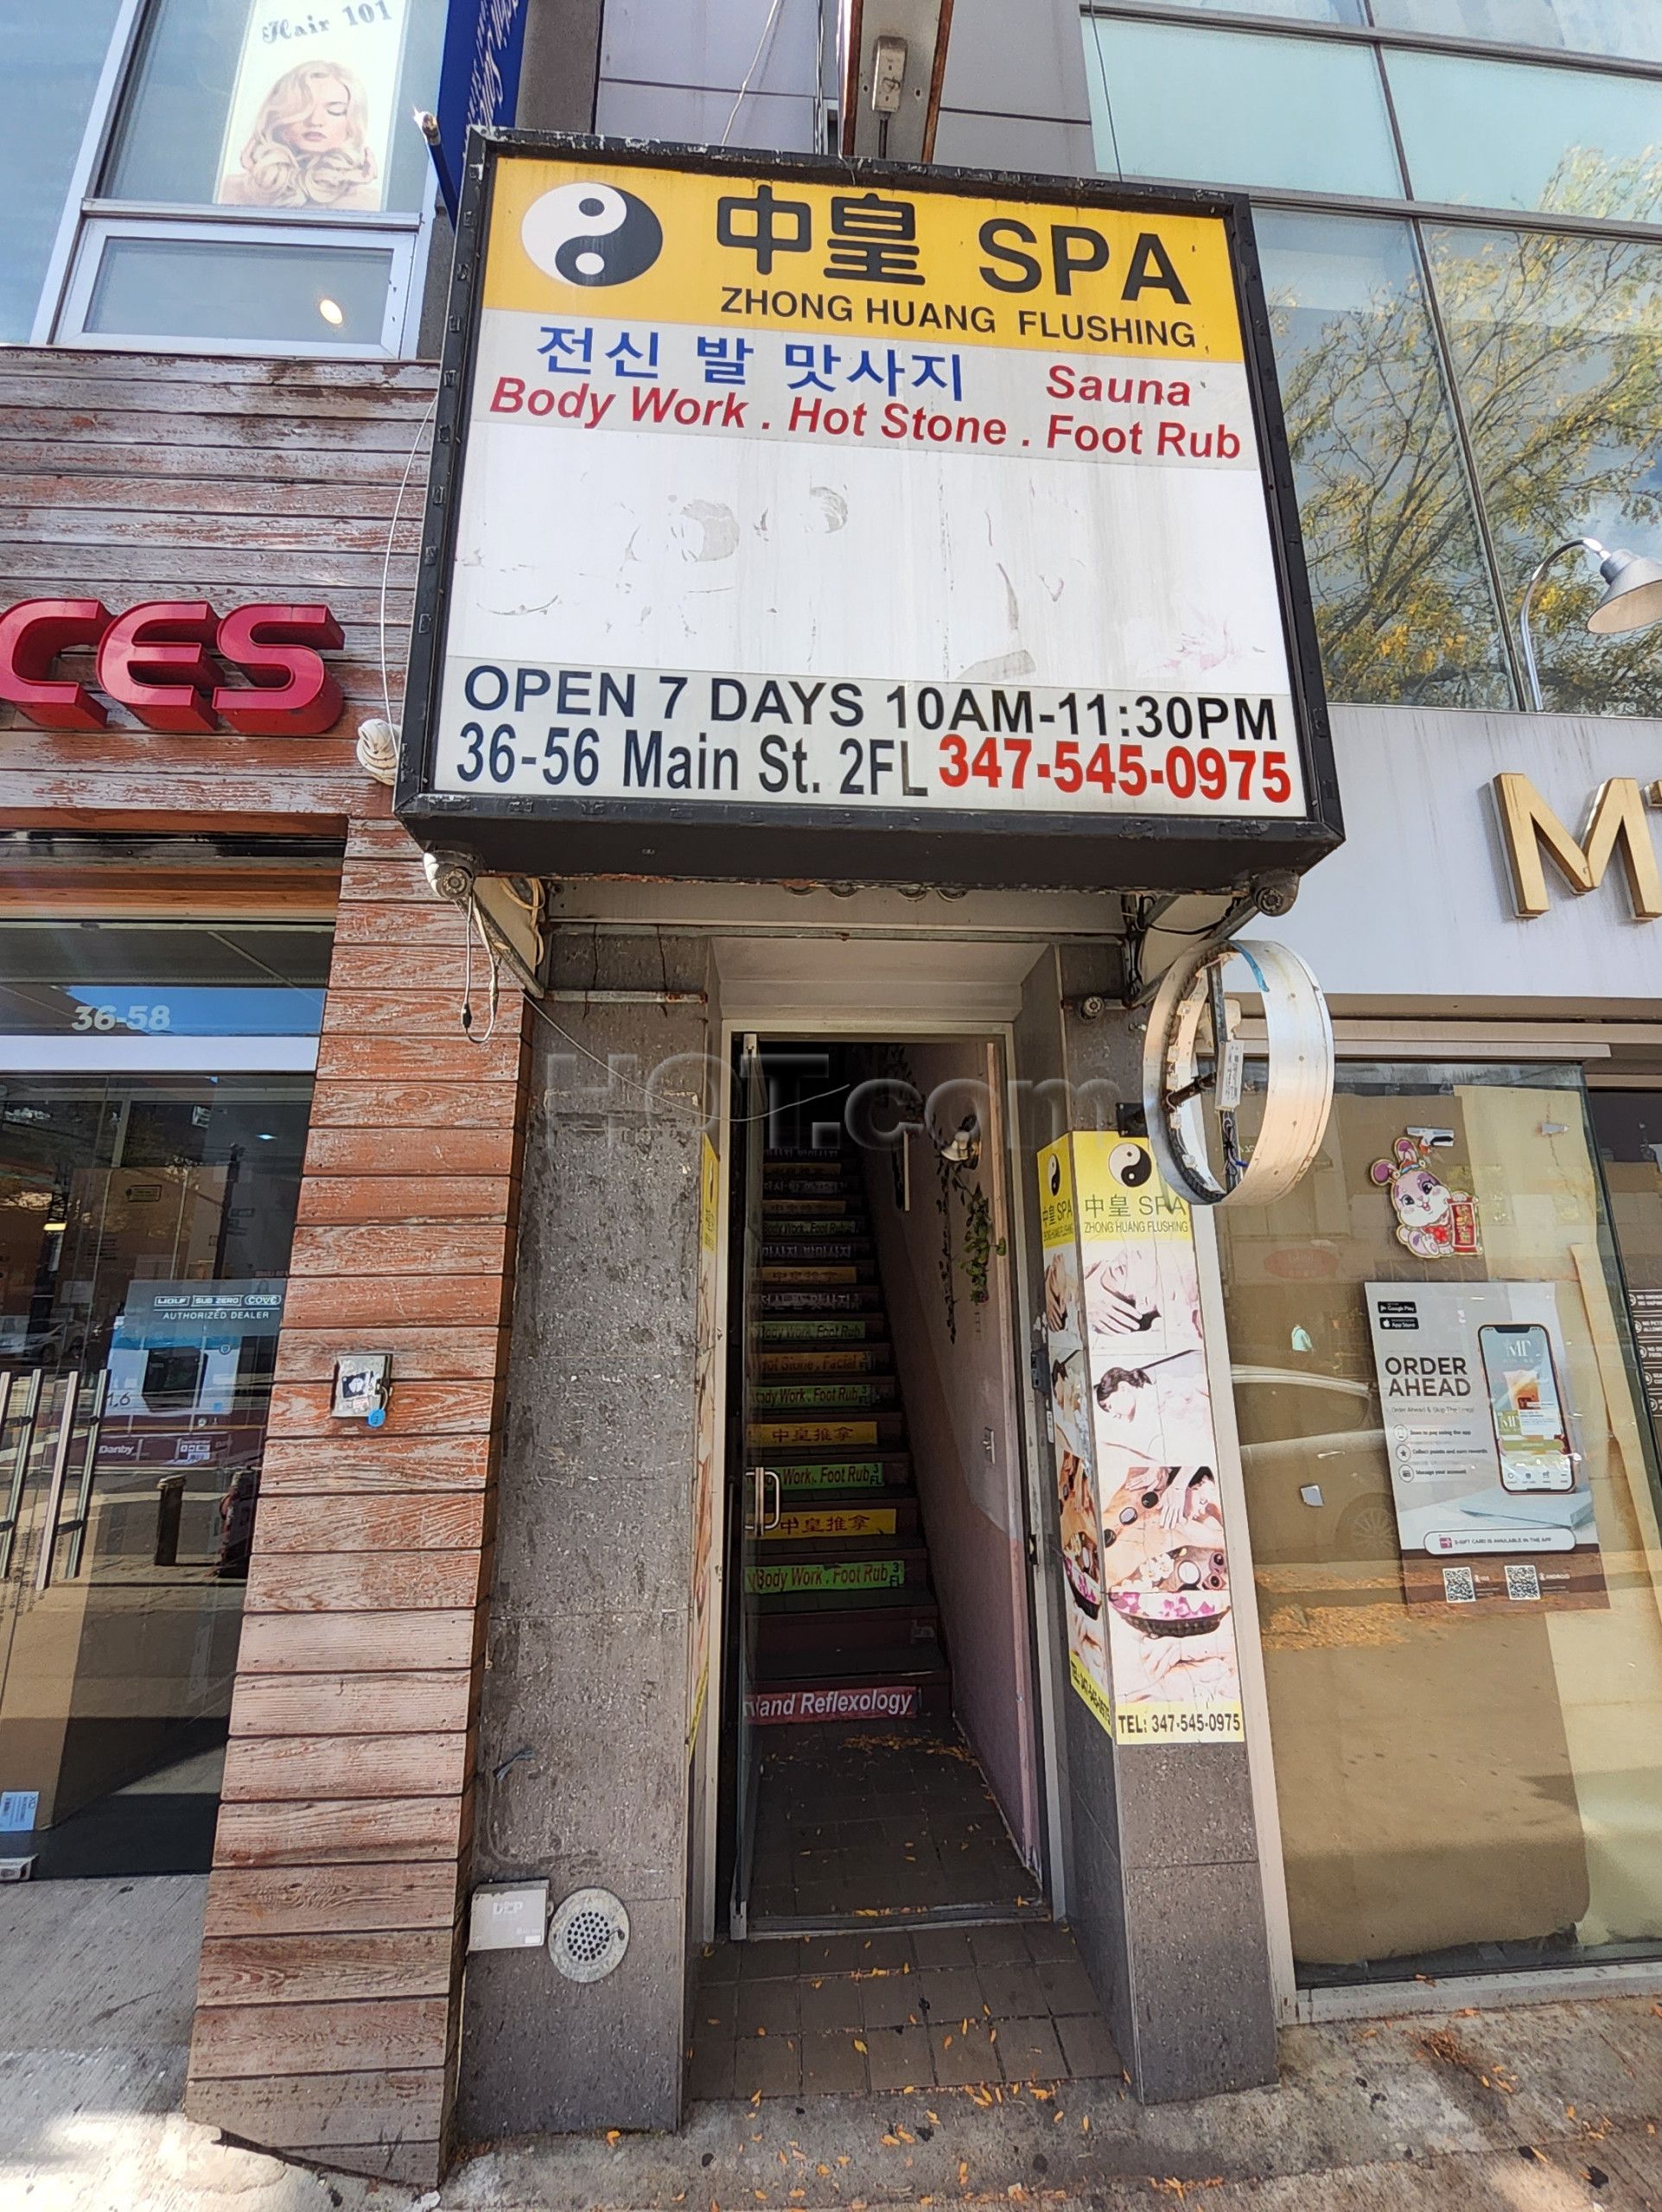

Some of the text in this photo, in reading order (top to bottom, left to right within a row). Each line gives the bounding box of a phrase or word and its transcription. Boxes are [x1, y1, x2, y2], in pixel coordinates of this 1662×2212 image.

[262, 0, 393, 44] Hair 101
[717, 184, 928, 285] 中皇
[979, 219, 1190, 304] SPA
[722, 288, 1194, 346] ZHONG HUANG FLUSHING
[538, 327, 961, 401] 전신 발 맛사지
[1048, 365, 1189, 405] Sauna
[491, 378, 1239, 458] Body Work Hot Stone Foot Rub
[465, 665, 1277, 741] OPEN 7 DAYS 10AM-11:30PM
[457, 722, 1290, 803] 36-56 Main St. 2FL 347-545-0975
[1493, 772, 1662, 920] M
[71, 1005, 170, 1032] 36-58
[1085, 1194, 1130, 1218] 中皇
[1139, 1195, 1187, 1216] SPA
[1085, 1221, 1113, 1233] ZHONG
[1115, 1220, 1145, 1233] HUANG
[1148, 1221, 1188, 1233] FLUSHING
[1385, 1357, 1468, 1376] ORDER
[813, 1387, 835, 1402] Foot
[837, 1387, 856, 1400] Rub
[1388, 1378, 1472, 1397] AHEAD
[99, 1446, 134, 1455] Danby
[819, 1466, 844, 1482] Foot
[848, 1465, 869, 1481] Rub
[832, 1566, 861, 1583] Foot
[863, 1563, 888, 1581] Rub
[799, 1691, 912, 1714] Reflexology
[1118, 1713, 1240, 1734] TEL: 347-545-0975
